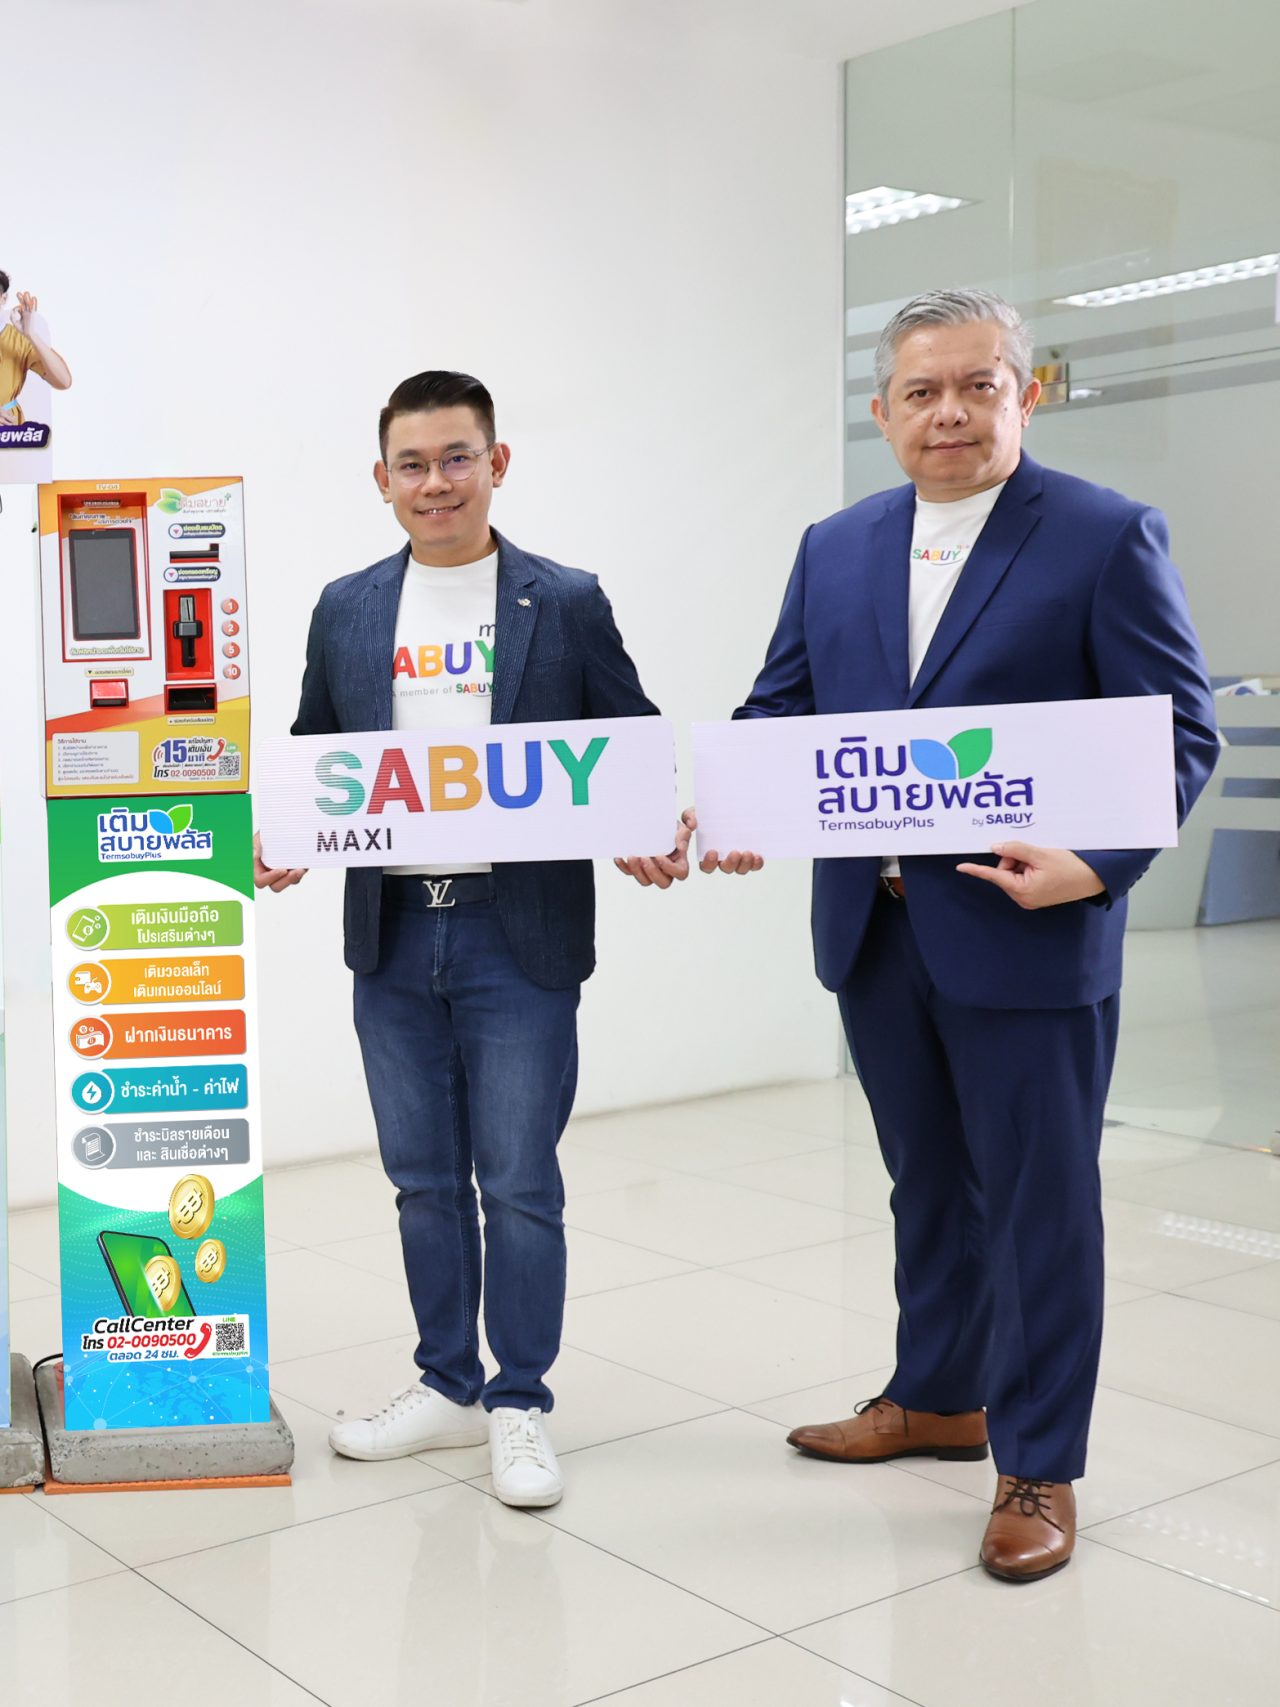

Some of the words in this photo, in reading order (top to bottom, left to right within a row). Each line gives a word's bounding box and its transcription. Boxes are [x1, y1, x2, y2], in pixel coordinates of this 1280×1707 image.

[912, 548, 960, 561] SABUY
[400, 687, 439, 697] member
[443, 686, 453, 694] of
[161, 740, 187, 763] 15
[816, 736, 908, 779] เติม
[154, 766, 170, 777] โทร
[314, 737, 610, 816] SABUY
[818, 771, 1034, 814] สบายพลัส
[99, 808, 147, 832] เติม
[819, 817, 935, 831] TermsabuyPlus
[972, 817, 984, 827] by
[986, 812, 1034, 825] SABUY
[100, 829, 211, 852] สบายพลัส
[316, 827, 393, 852] MAXI
[131, 906, 219, 926] เติมเงินมือถือ
[137, 928, 215, 944] โปรเสริมต่างๆ
[144, 961, 210, 979] เติมวอลเล็ท
[133, 980, 222, 998] เติมเกมออนไลน์
[125, 1026, 233, 1044] ฝากเงินธนาคาร
[121, 1075, 187, 1098] ชำระค่าน้ำ
[204, 1077, 240, 1095] ค่าไฟ
[134, 1125, 230, 1142] ชำระบิลรายเดือน
[136, 1149, 157, 1162] และ
[160, 1142, 229, 1161] สินเชื่อต่างๆ
[94, 1317, 195, 1334] CallCenter
[83, 1335, 104, 1350] โทร
[107, 1333, 197, 1349] 02-0090500
[109, 1351, 142, 1361] ตลอด
[144, 1350, 158, 1359] 24
[161, 1350, 179, 1359] ชม.
